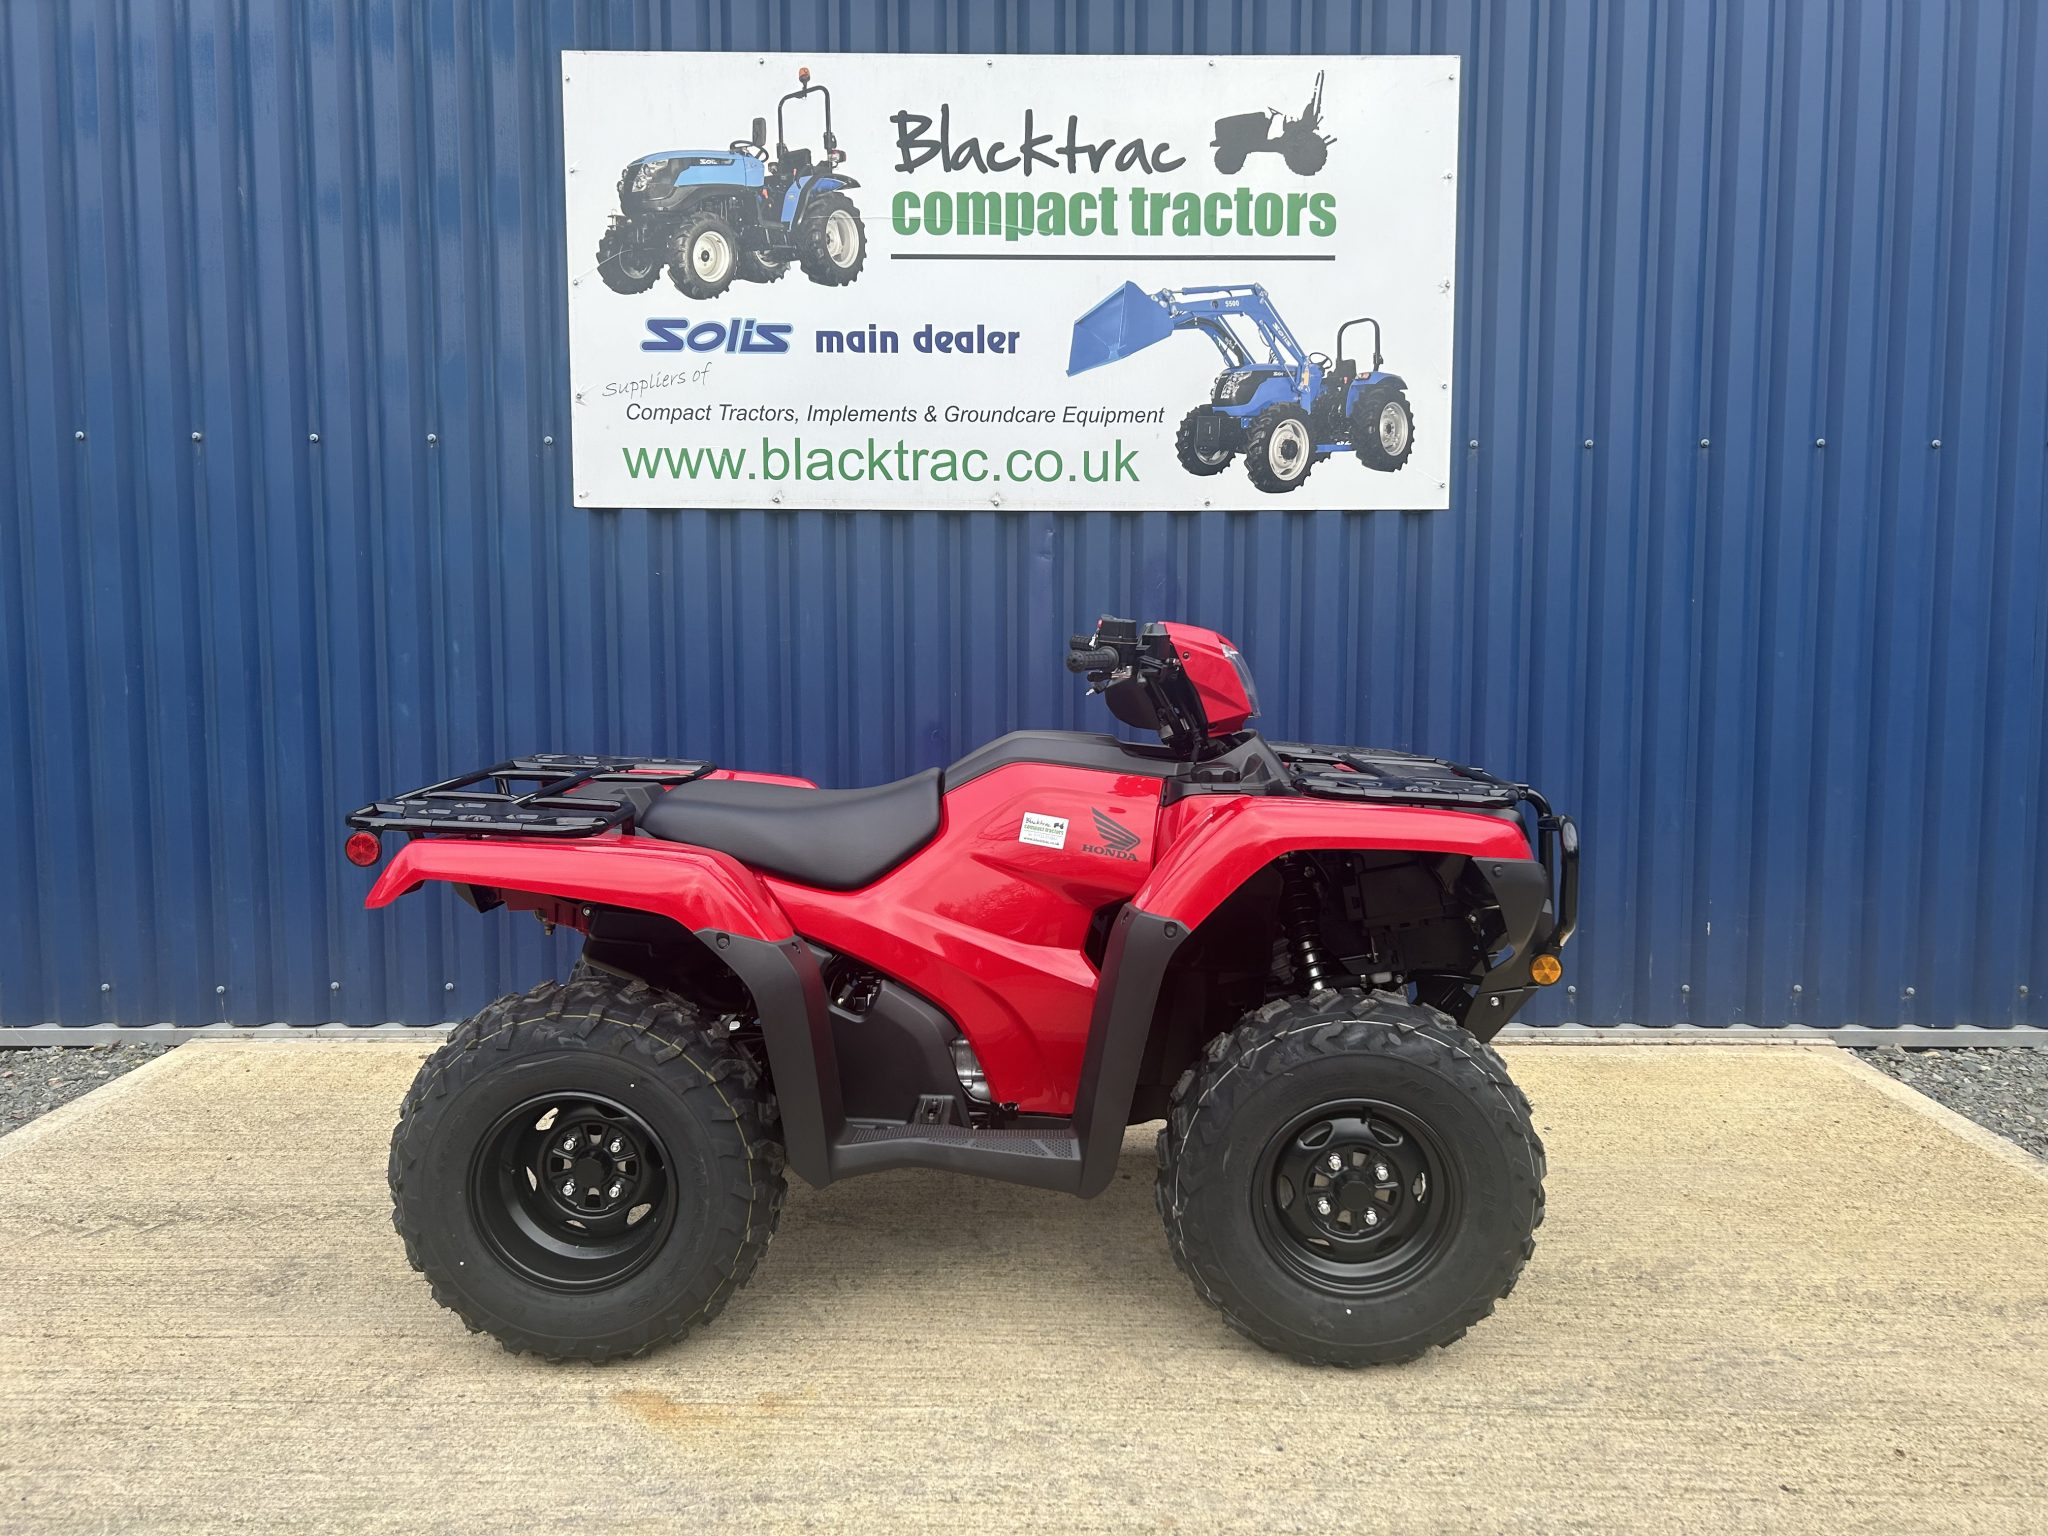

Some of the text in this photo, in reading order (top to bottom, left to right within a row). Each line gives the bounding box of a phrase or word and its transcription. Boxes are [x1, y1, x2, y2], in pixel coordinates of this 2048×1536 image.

[890, 104, 1187, 177] Blacktrac
[891, 187, 1337, 241] compact tractors
[815, 324, 899, 354] main
[912, 324, 1021, 354] dealer
[602, 361, 713, 399] Suppliers of
[626, 403, 1165, 428] Compact Tractors, Implements & Groundcare Equipment
[621, 436, 1140, 482] www.blacktrac.co.uk
[1081, 844, 1138, 862] HONDA
